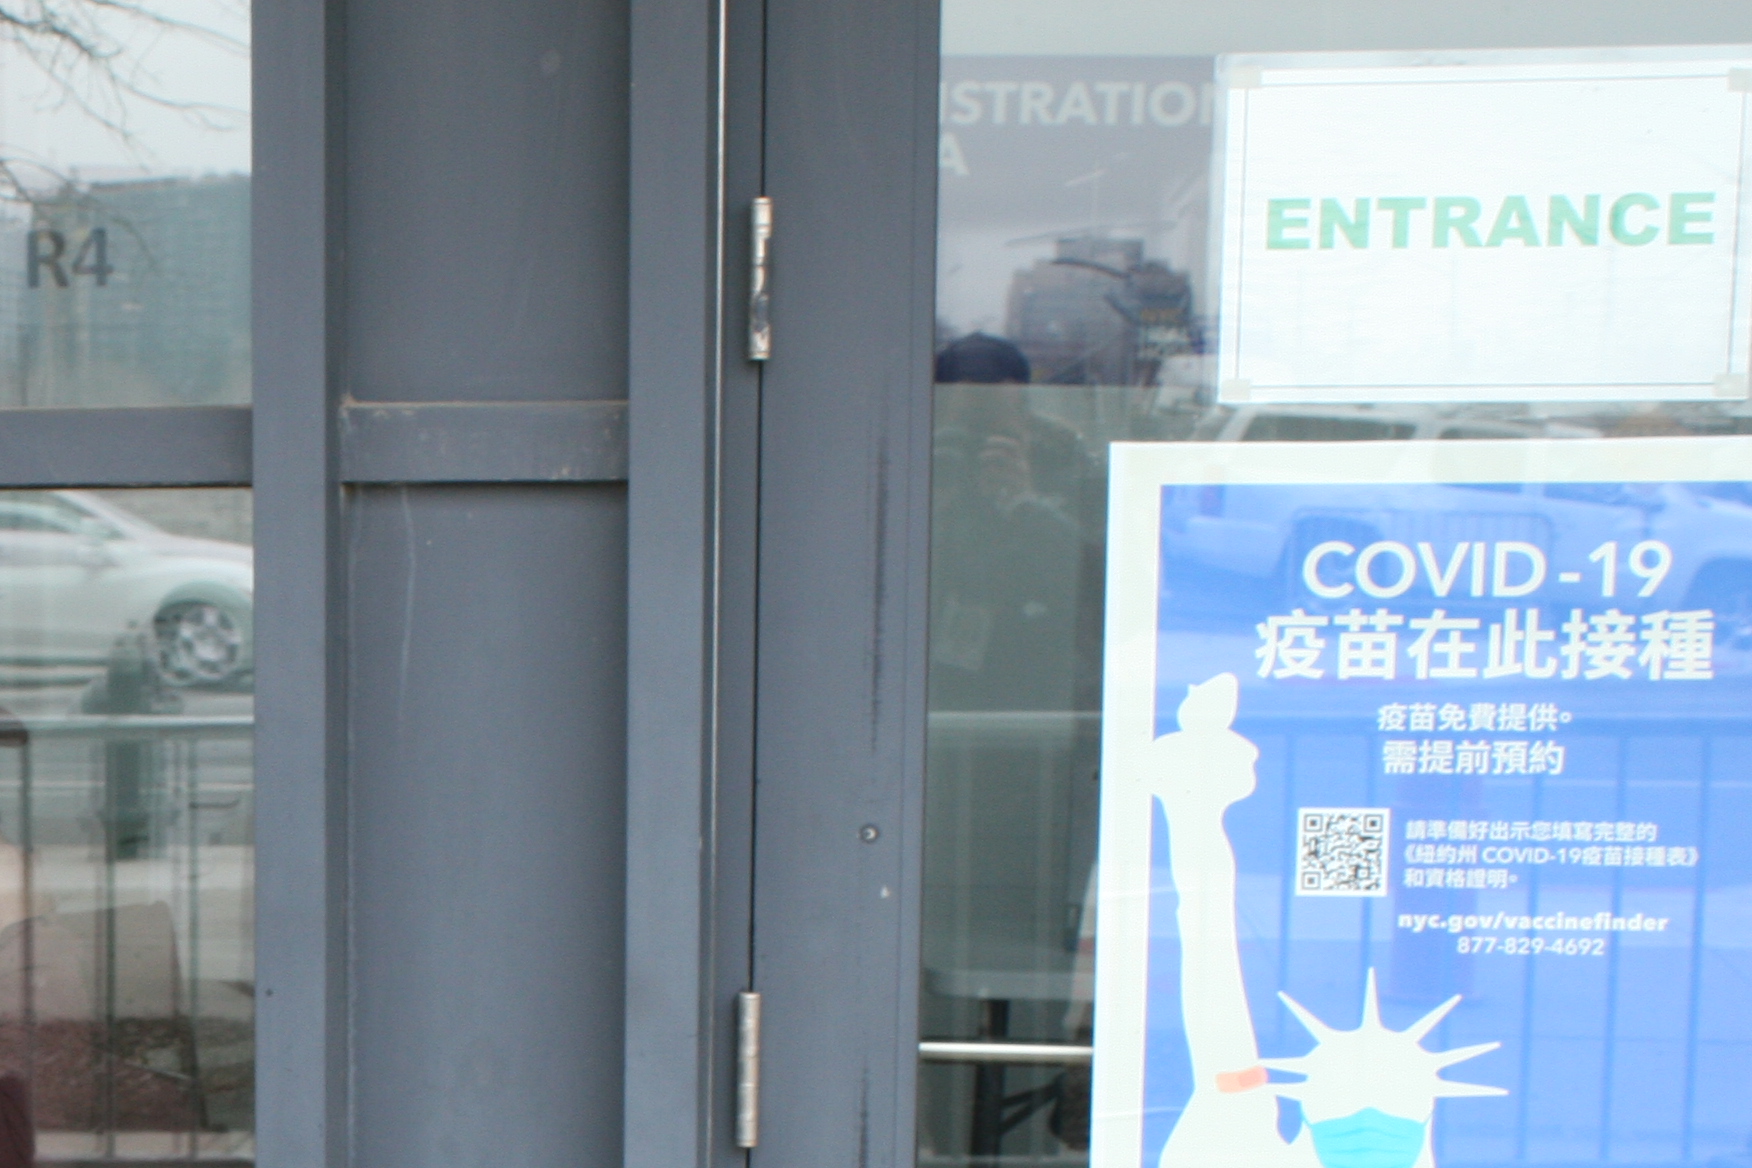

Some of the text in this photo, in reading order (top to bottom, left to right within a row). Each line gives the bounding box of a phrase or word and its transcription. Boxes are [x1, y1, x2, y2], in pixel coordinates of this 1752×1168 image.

[1266, 191, 1716, 251] ENTRANCE
[25, 227, 113, 290] R4
[1254, 608, 1716, 682] 疫苗在此接種
[1376, 702, 1573, 733] 疫苗免費提供。
[1381, 740, 1565, 776] 需提前預約
[1398, 912, 1669, 933] nyc.gov/vaccinefinder
[1456, 936, 1606, 956] 877-829-4692
